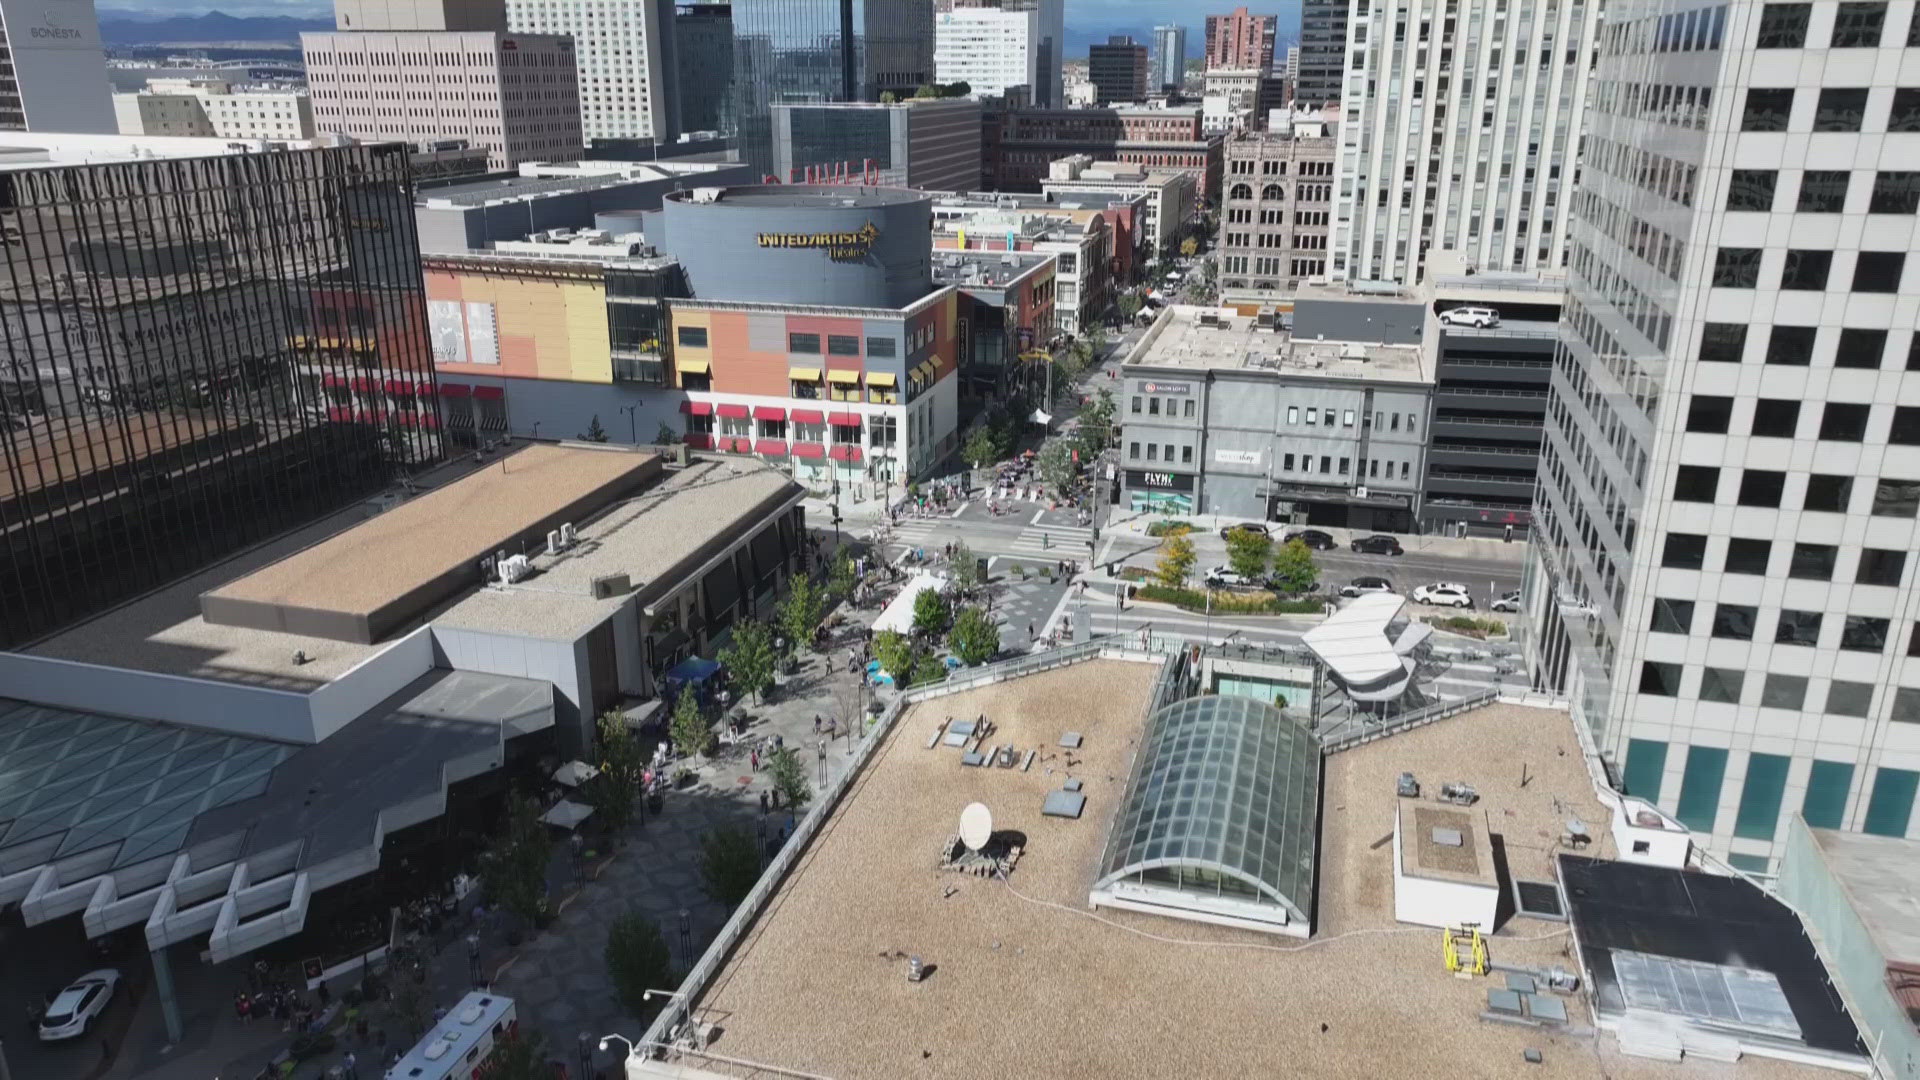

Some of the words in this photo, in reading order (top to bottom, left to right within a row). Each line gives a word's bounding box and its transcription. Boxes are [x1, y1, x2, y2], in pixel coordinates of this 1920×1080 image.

[31, 28, 81, 39] SONESTA
[757, 232, 807, 247] UNITED
[808, 231, 868, 246] ARTISTS
